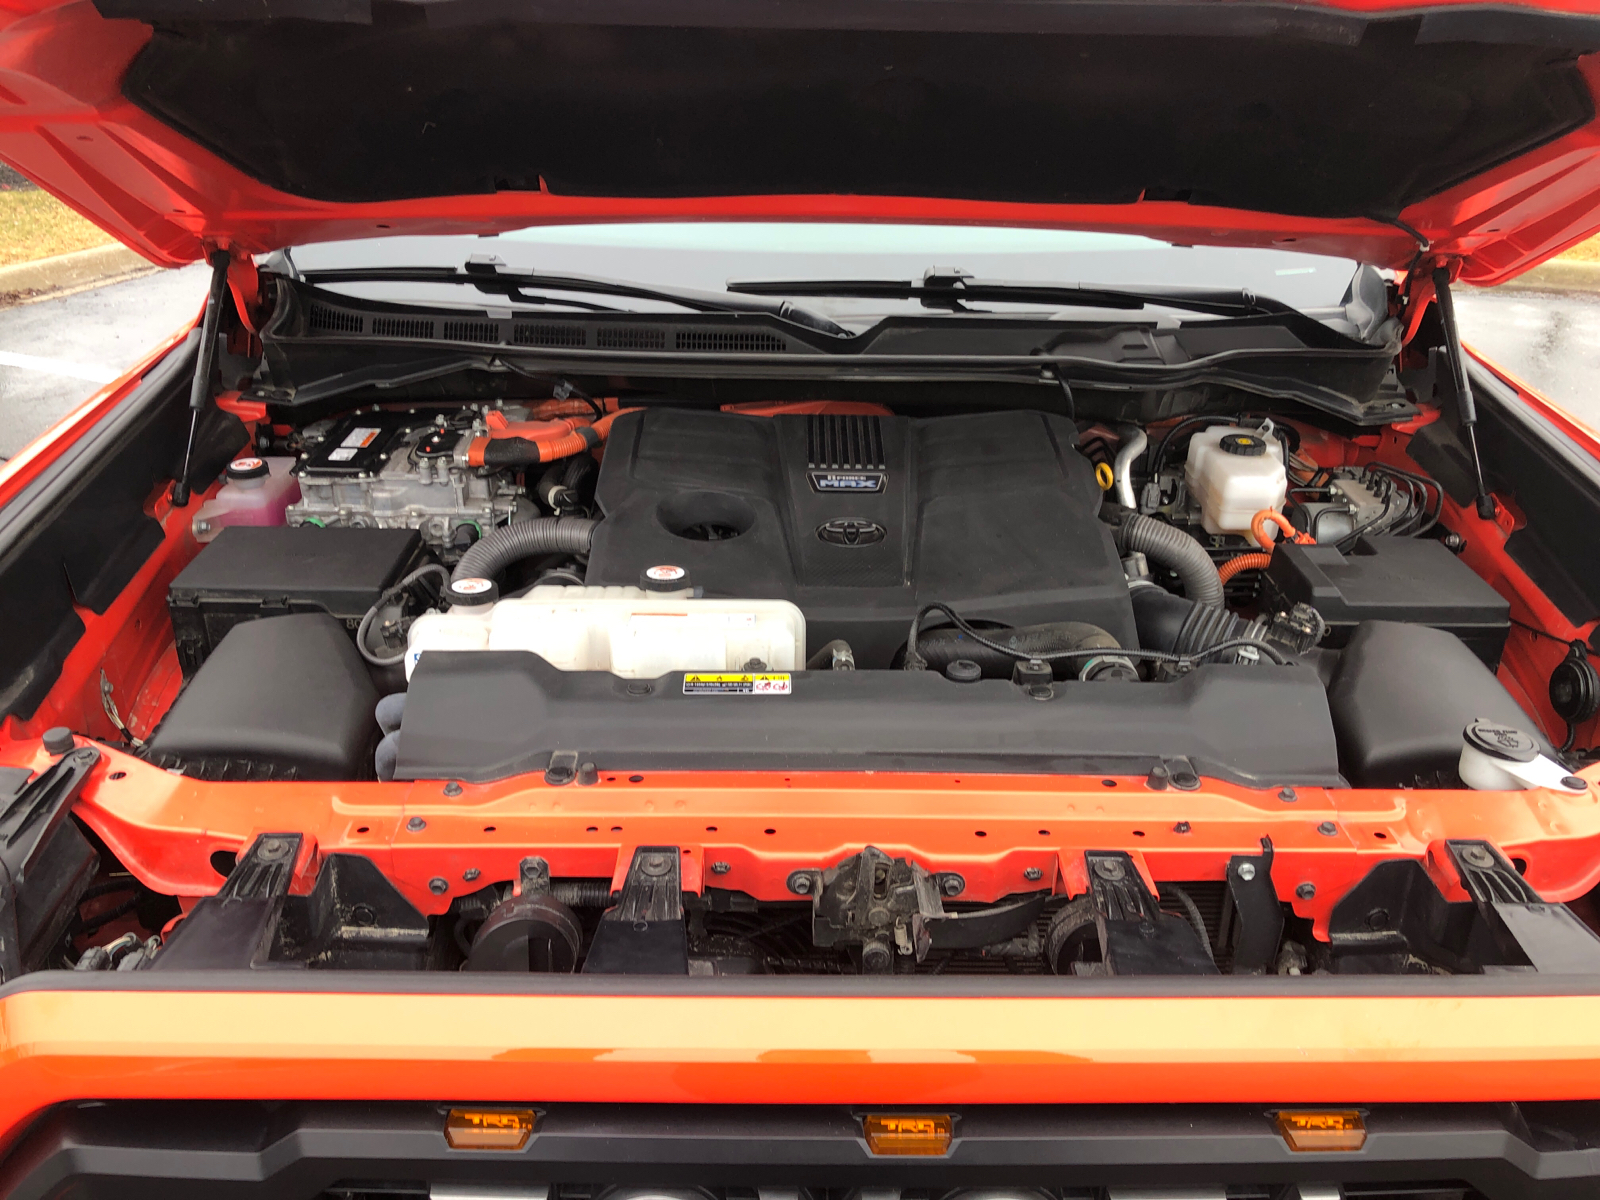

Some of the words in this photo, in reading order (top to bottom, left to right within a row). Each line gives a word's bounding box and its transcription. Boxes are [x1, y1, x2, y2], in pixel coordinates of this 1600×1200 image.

[819, 479, 876, 488] MAX
[464, 1113, 520, 1129] TRD
[880, 1118, 935, 1134] TRD
[1291, 1114, 1344, 1130] TRD
